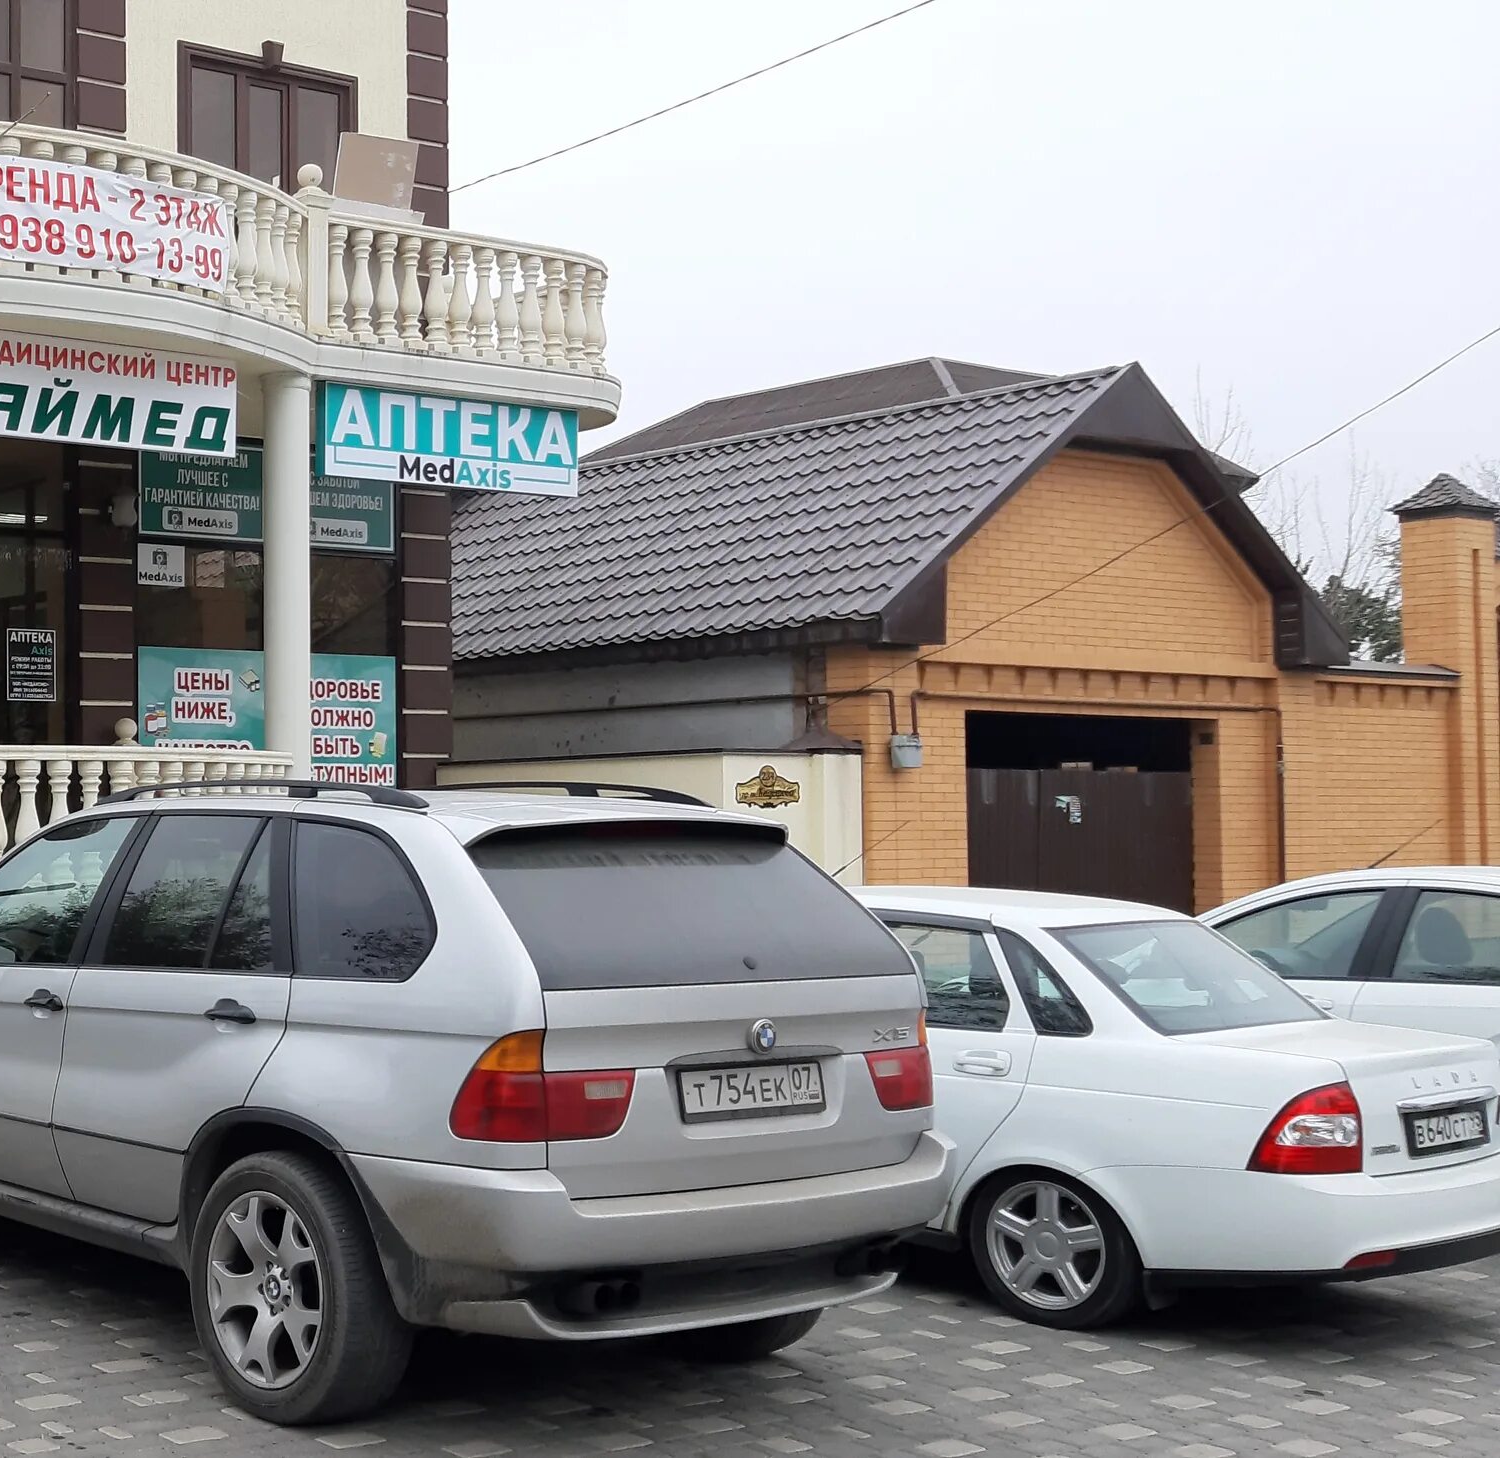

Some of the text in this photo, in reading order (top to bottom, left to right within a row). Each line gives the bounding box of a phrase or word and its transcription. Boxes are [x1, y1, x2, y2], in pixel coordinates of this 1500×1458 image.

[129, 189, 145, 222] 2
[155, 194, 225, 238] ЭТАЖ
[75, 223, 223, 282] 910-13-99
[165, 362, 235, 388] ЦЕНТР
[331, 389, 574, 466] АПТЕКА
[177, 469, 228, 487] ЛУЧШЕЕ С
[399, 455, 512, 489] MedAxis
[145, 487, 260, 511] ГАРАНТИЕЙ КАЧЕСТВА!
[332, 493, 383, 511] ЗДОРОВЬЕ!
[188, 516, 233, 529] MedAxis
[321, 527, 363, 539] MedAxis
[139, 571, 182, 583] MedAxis
[10, 632, 53, 643] АПТЕКА
[31, 646, 53, 656] Axis
[177, 671, 230, 692] ЦЕНЫ
[174, 701, 233, 722] НИЖЕ,
[311, 709, 373, 727] ОЛЖНО
[313, 737, 360, 755] БЫТЬ
[311, 765, 393, 783] ТУПНЫМ!
[792, 1067, 811, 1090] 07
